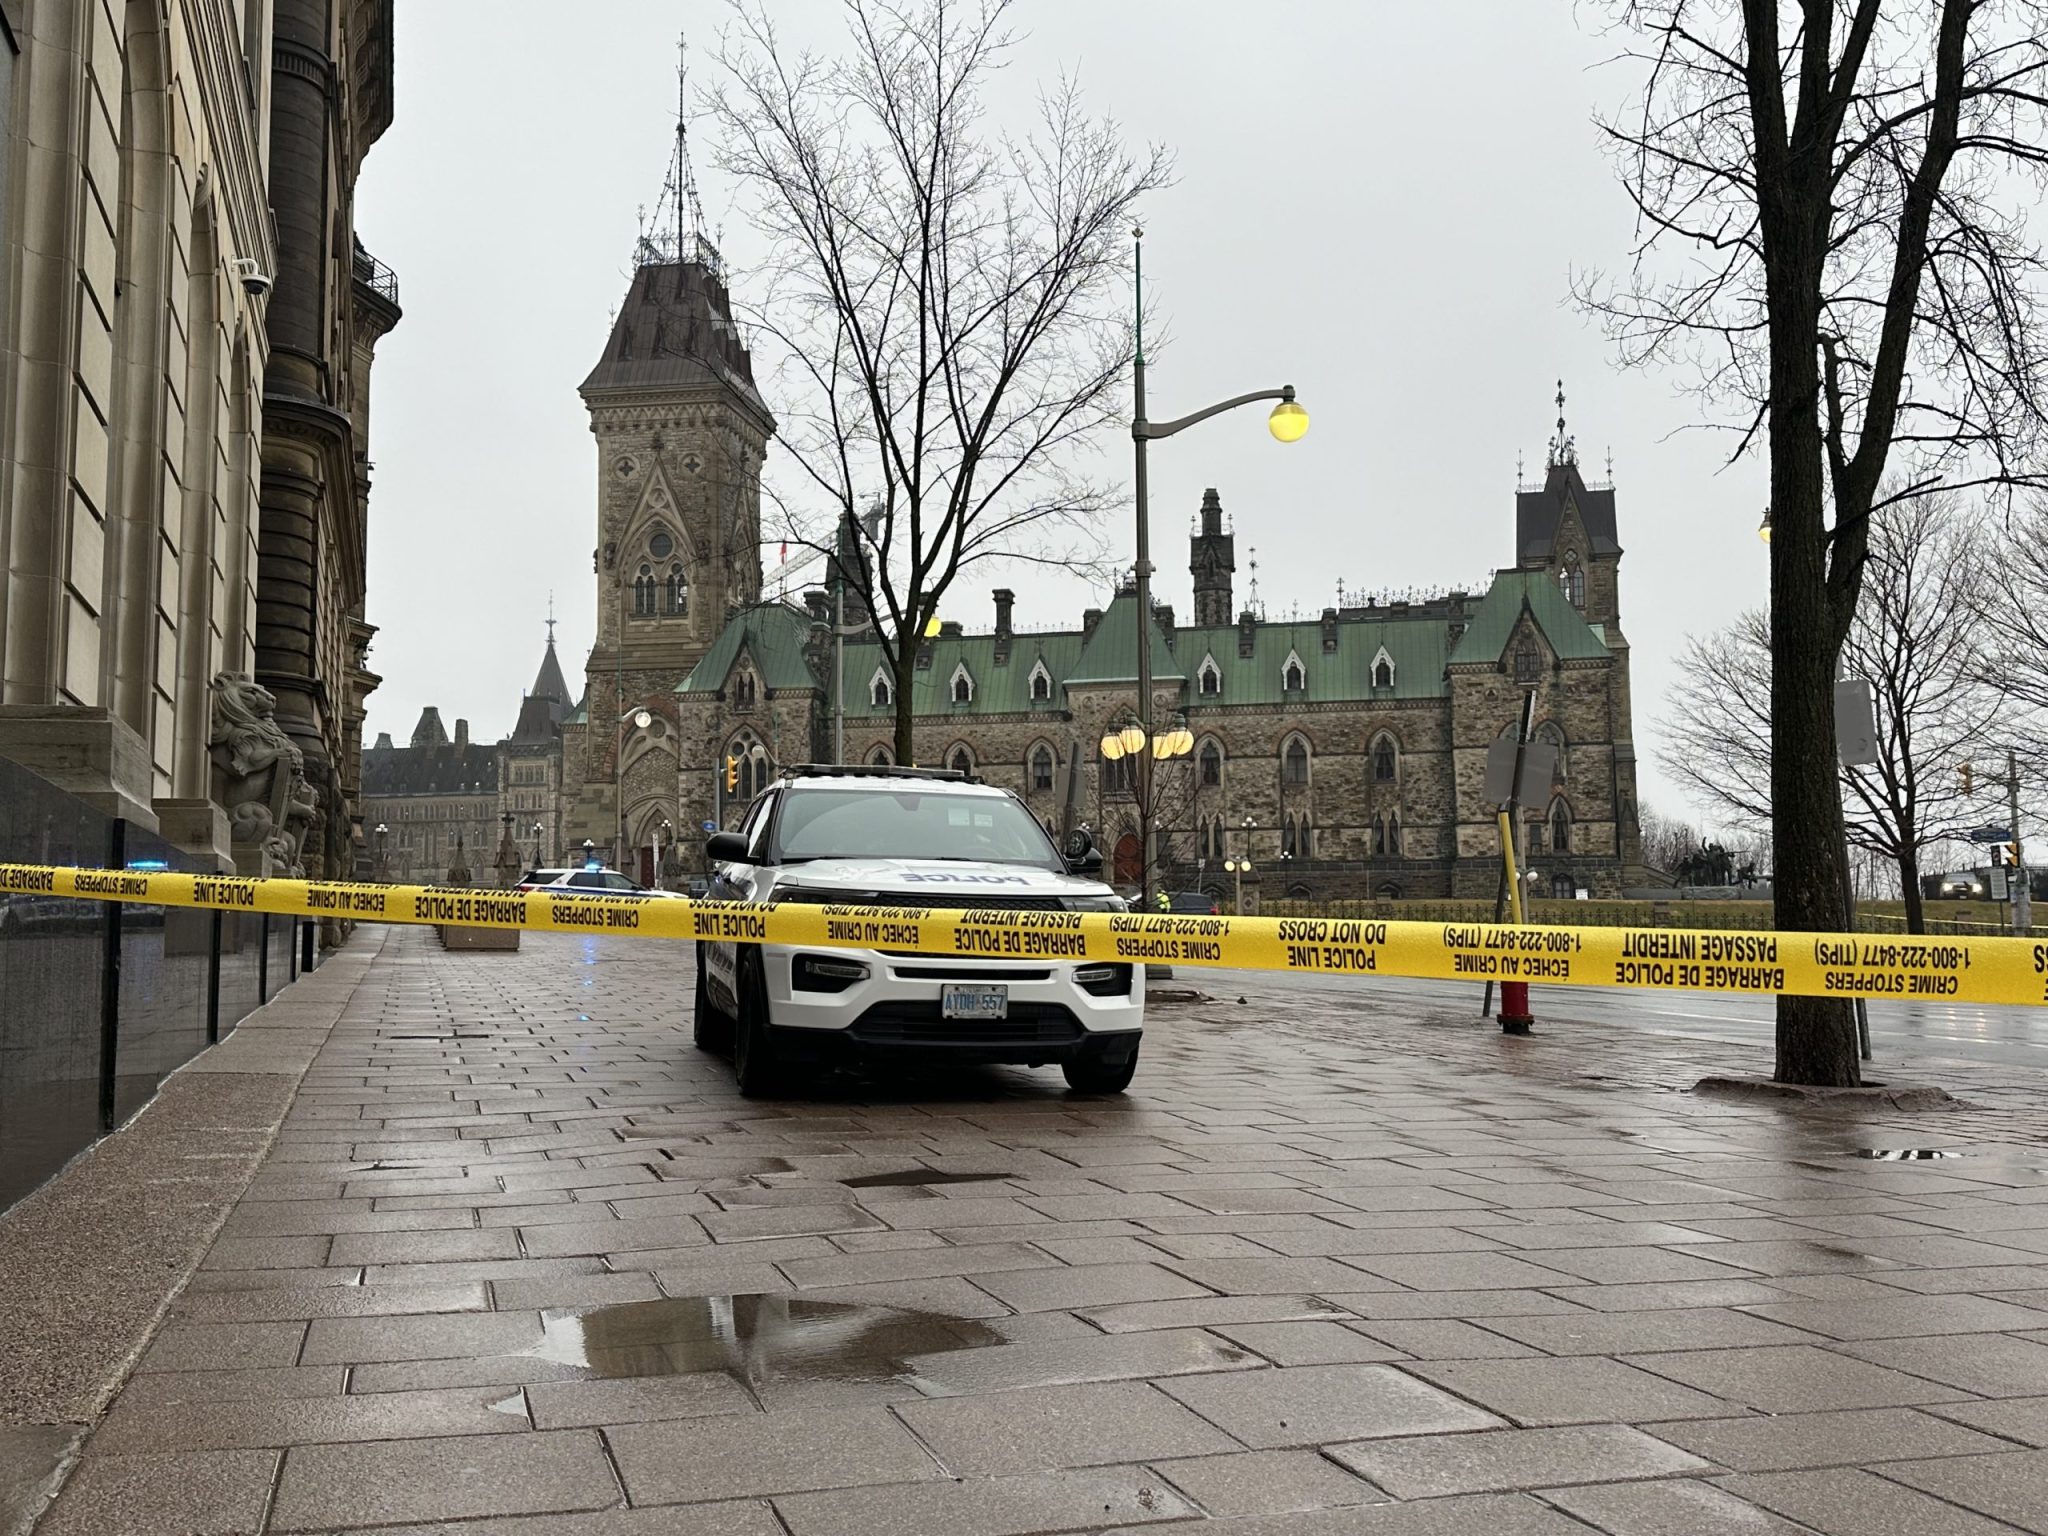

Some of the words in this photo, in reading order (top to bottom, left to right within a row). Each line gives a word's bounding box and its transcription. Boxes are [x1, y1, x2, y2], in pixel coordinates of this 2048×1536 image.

[8, 869, 54, 891] BARRAGE
[74, 875, 118, 894] STOPPERS
[120, 878, 147, 896] CRIME
[193, 882, 216, 903] LINE
[218, 884, 254, 906] POLICE
[307, 889, 336, 908] CRIME
[339, 892, 352, 909] AU
[353, 893, 385, 916] ÉCHEC
[416, 897, 454, 920] POLICE
[457, 899, 471, 920] DE
[474, 900, 526, 924] BARRAGE
[552, 905, 604, 926] STOPPERS
[607, 909, 638, 928] CRIME
[694, 913, 720, 935] LINE
[723, 914, 765, 938] POLICE
[1110, 917, 1143, 932] (TIPS)
[828, 921, 862, 941] CRIME
[865, 923, 879, 941] AU
[882, 924, 919, 948] ÉCHEC
[1146, 919, 1229, 936] 1-800-222-8477
[1279, 921, 1327, 942] CROSS
[1330, 923, 1360, 943] NOT
[1365, 924, 1386, 944] DO
[1444, 927, 1480, 948] (TIPS)
[954, 928, 1000, 951] POLICE
[1003, 931, 1021, 952] DE
[1024, 932, 1086, 955] BARRAGE
[1117, 938, 1179, 958] STOPPERS
[1485, 931, 1581, 952] 1-800-222-8477
[1622, 933, 1695, 960] INTERDIT
[1701, 936, 1777, 962] PASSAGE
[1182, 942, 1220, 960] CRIME
[1288, 946, 1320, 967] LINE
[1323, 948, 1376, 969] POLICE
[1815, 939, 1857, 966] (TIPS)
[1863, 945, 1971, 969] 1-800-222-8477
[1454, 954, 1497, 973] CRIME
[1502, 956, 1519, 974] AU
[1523, 957, 1569, 980] ÉCHEC
[1616, 963, 1673, 985] POLICE
[1679, 965, 1700, 986] DE
[1705, 966, 1784, 989] BARRAGE
[1826, 972, 1904, 992] STOPPERS
[1909, 975, 1958, 994] CRIME
[982, 994, 1004, 1011] 557
